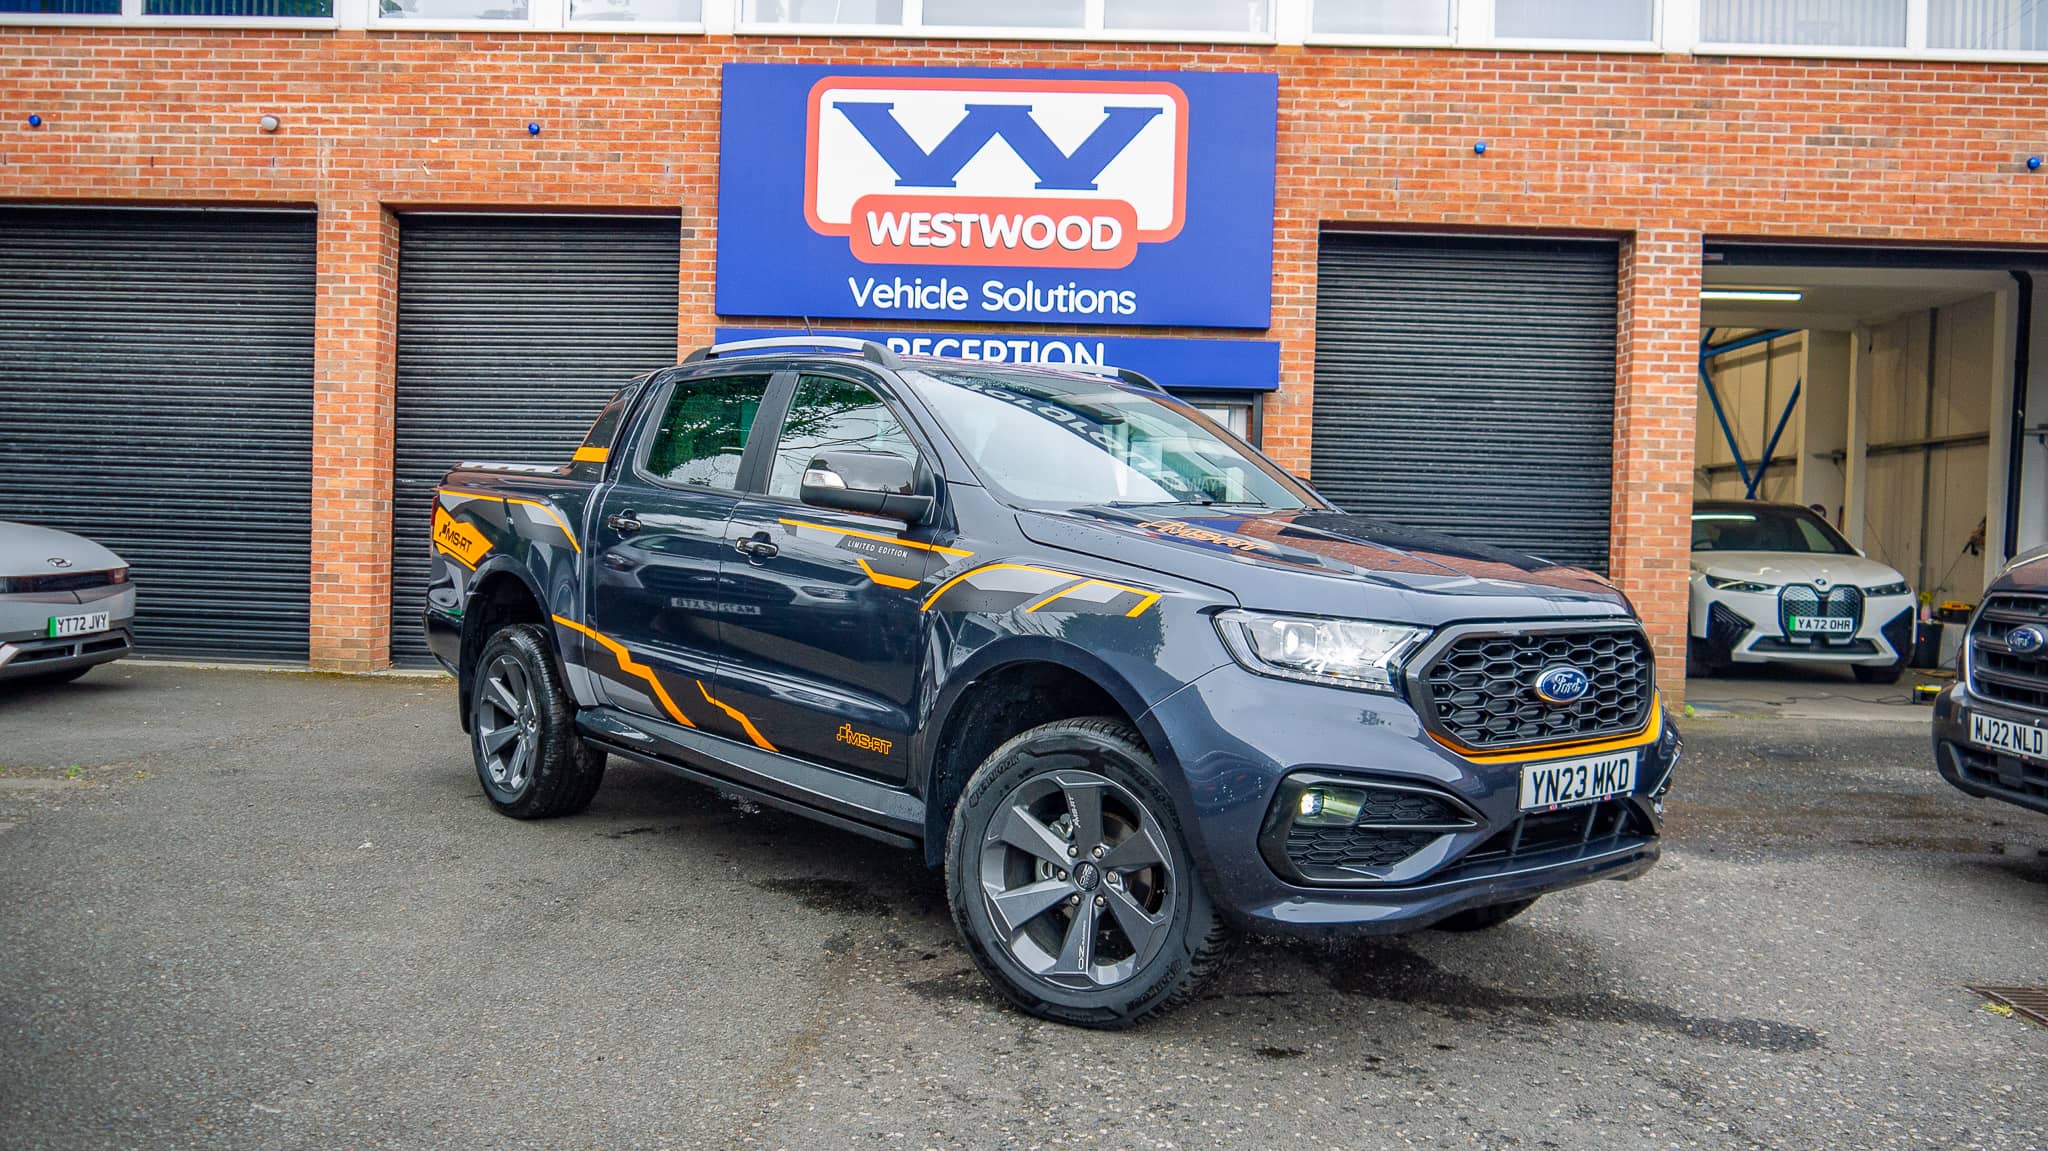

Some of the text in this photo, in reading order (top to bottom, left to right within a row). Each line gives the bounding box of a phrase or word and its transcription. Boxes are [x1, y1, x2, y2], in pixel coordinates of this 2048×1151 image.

[865, 211, 1122, 250] WESTWOOD
[848, 276, 1137, 315] Vehicle Solutions
[847, 540, 909, 559] LIMITED EDITION
[57, 613, 107, 633] YT72 JVY
[1798, 619, 1828, 630] YA72
[1552, 673, 1581, 694] Ford
[1975, 716, 2043, 755] MJ22 NLD
[1532, 758, 1630, 805] YN23 MKD
